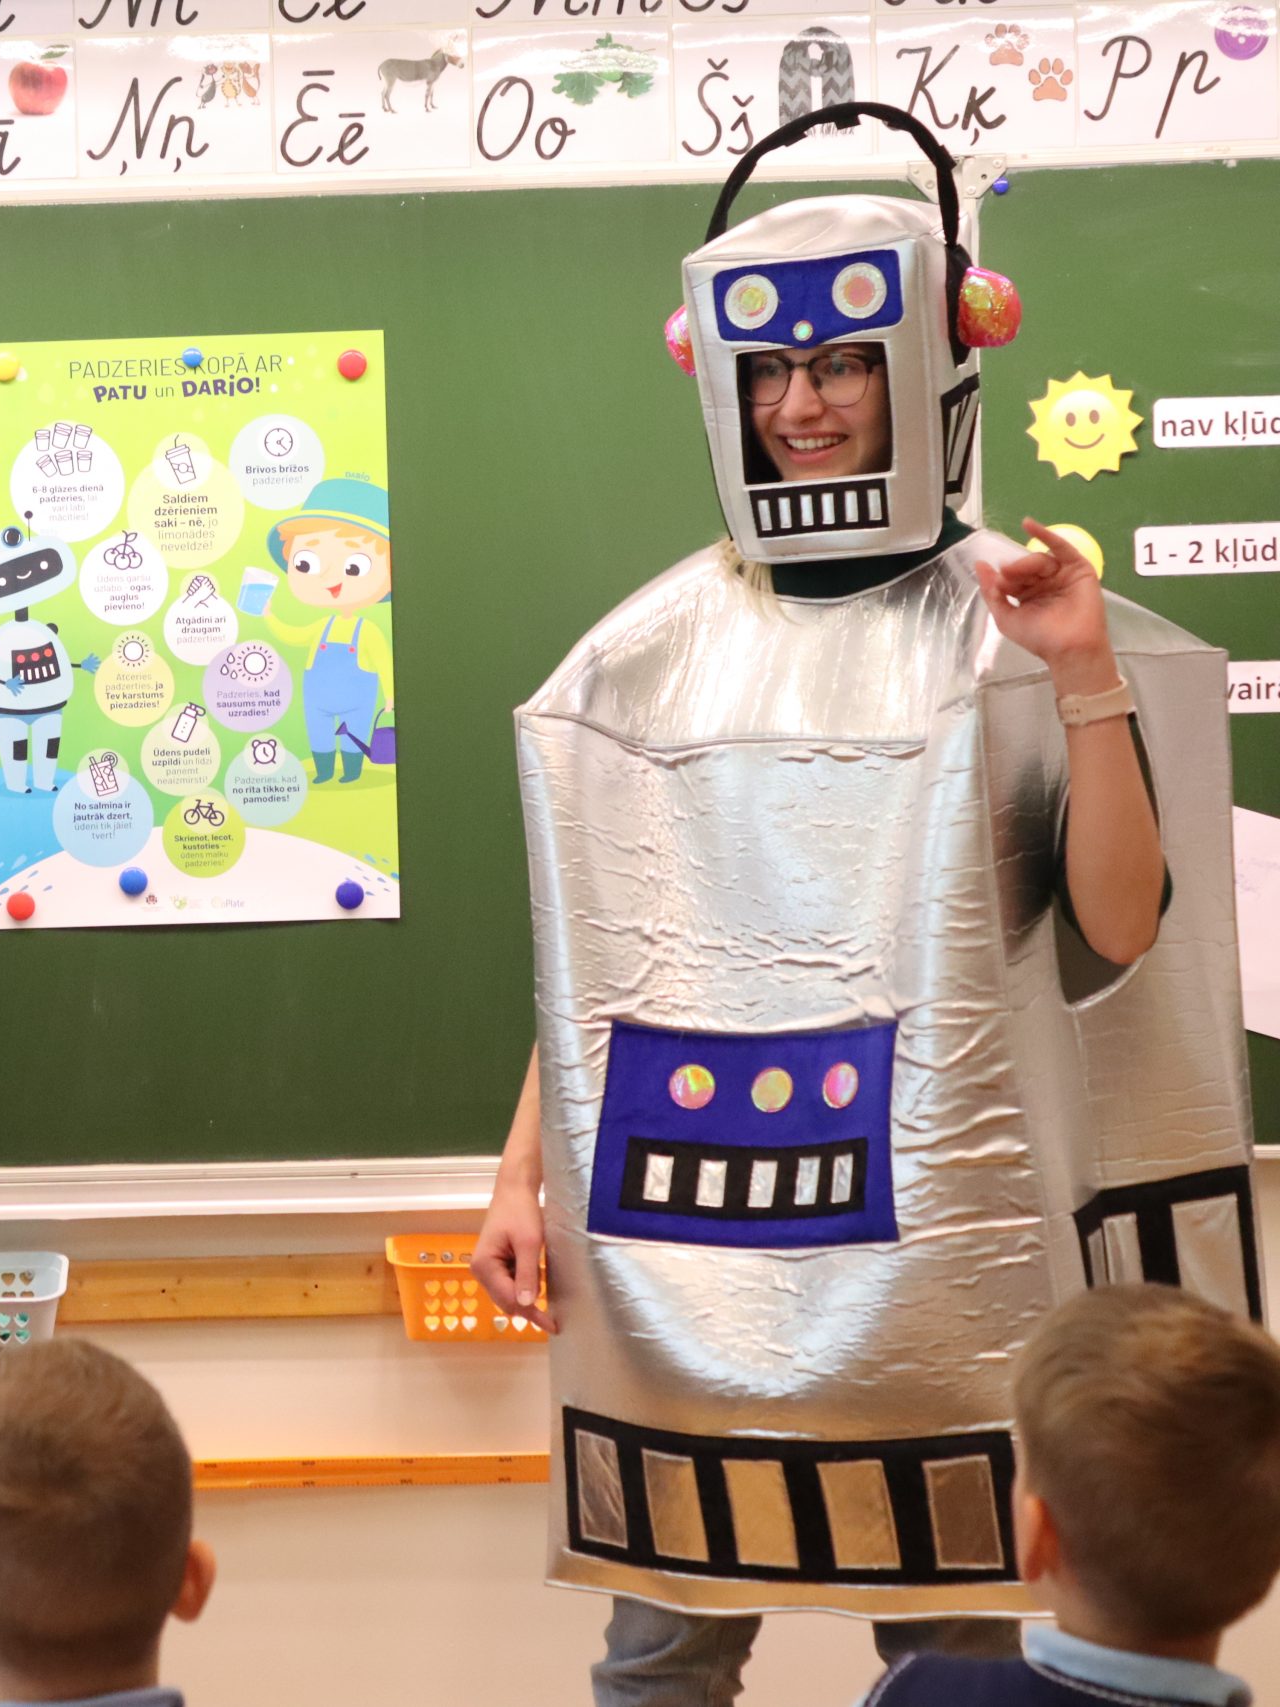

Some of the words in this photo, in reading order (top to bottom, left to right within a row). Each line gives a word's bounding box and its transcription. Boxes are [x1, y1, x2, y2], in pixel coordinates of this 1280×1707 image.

[476, 75, 576, 162] Oo
[69, 357, 187, 380] PADZERIES
[255, 354, 283, 374] AR
[92, 384, 148, 403] PATU
[154, 386, 175, 398] un
[1161, 418, 1214, 437] nav
[252, 475, 303, 487] padzeries!
[32, 485, 47, 494] 6-8
[39, 494, 86, 504] padzeries,
[162, 493, 209, 504] Saldiem
[154, 504, 218, 517] dzērieniem
[154, 517, 178, 528] saki
[189, 517, 206, 529] nē,
[207, 516, 219, 529] jo
[158, 528, 216, 541] limonādes
[160, 540, 214, 552] neveldzē!
[1143, 544, 1158, 565] 1
[1189, 542, 1204, 563] 2
[130, 584, 154, 593] ogas,
[104, 602, 145, 612] pievieno!
[176, 616, 213, 626] Atgādini
[181, 626, 221, 635] draugam
[154, 681, 164, 691] ja
[1226, 675, 1280, 700] air
[105, 692, 120, 700] Tev
[122, 691, 165, 700] karstums
[263, 688, 281, 698] kad
[216, 700, 256, 708] sausums
[152, 758, 181, 767] uzpildi
[281, 774, 297, 784] kad
[262, 785, 285, 794] tikko
[286, 784, 300, 793] esi
[243, 794, 290, 804] pamodies!
[74, 802, 87, 810] No
[124, 800, 132, 809] ir
[73, 811, 105, 823] jautrāk
[100, 821, 112, 830] tik
[91, 830, 116, 840] tvert!
[182, 842, 220, 850] kustoties
